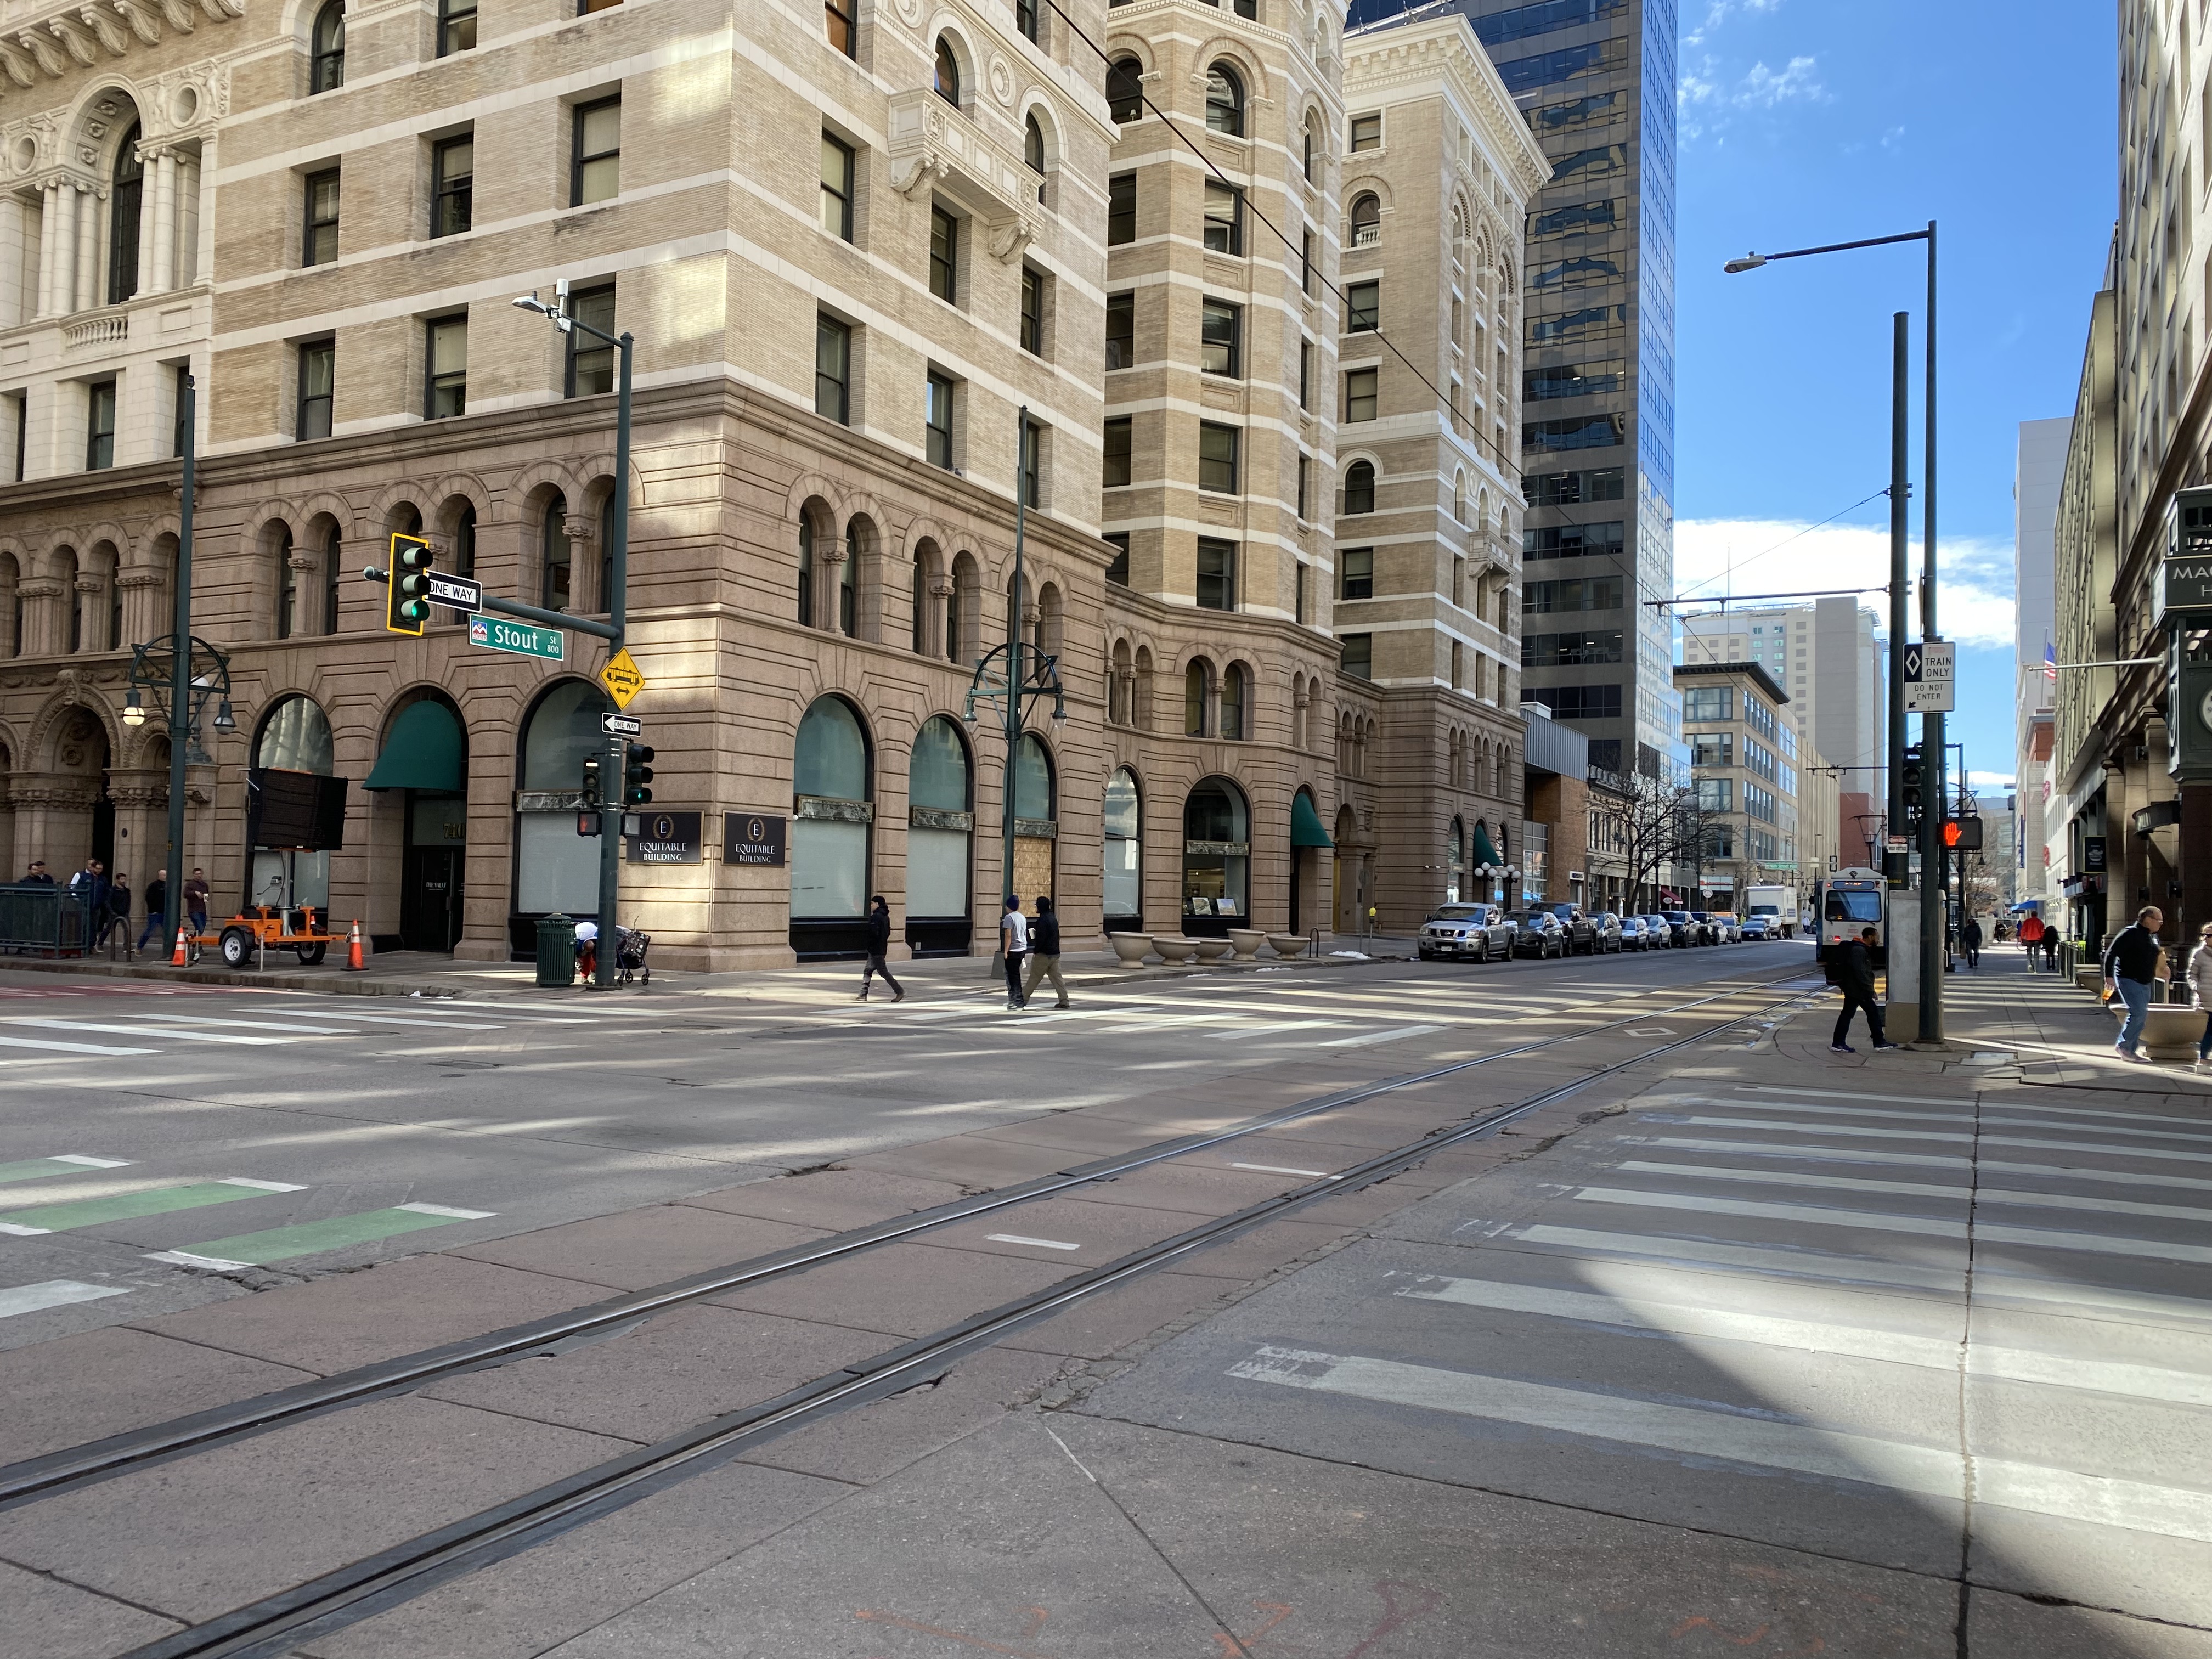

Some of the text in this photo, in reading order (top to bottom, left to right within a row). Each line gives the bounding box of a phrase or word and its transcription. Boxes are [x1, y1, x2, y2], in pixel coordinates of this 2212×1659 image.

[430, 580, 473, 601] ONE WAY
[494, 625, 538, 651] Stout
[550, 636, 556, 645] St
[547, 645, 560, 654] 800
[1925, 657, 1951, 667] TRAIN
[1926, 668, 1950, 678] ONLY
[614, 720, 625, 729] ONE
[660, 821, 667, 834] E
[753, 823, 759, 836] E
[639, 842, 687, 854] EQUITABLE
[735, 843, 775, 855] EQUITABLE
[738, 855, 771, 863] BUILDING
